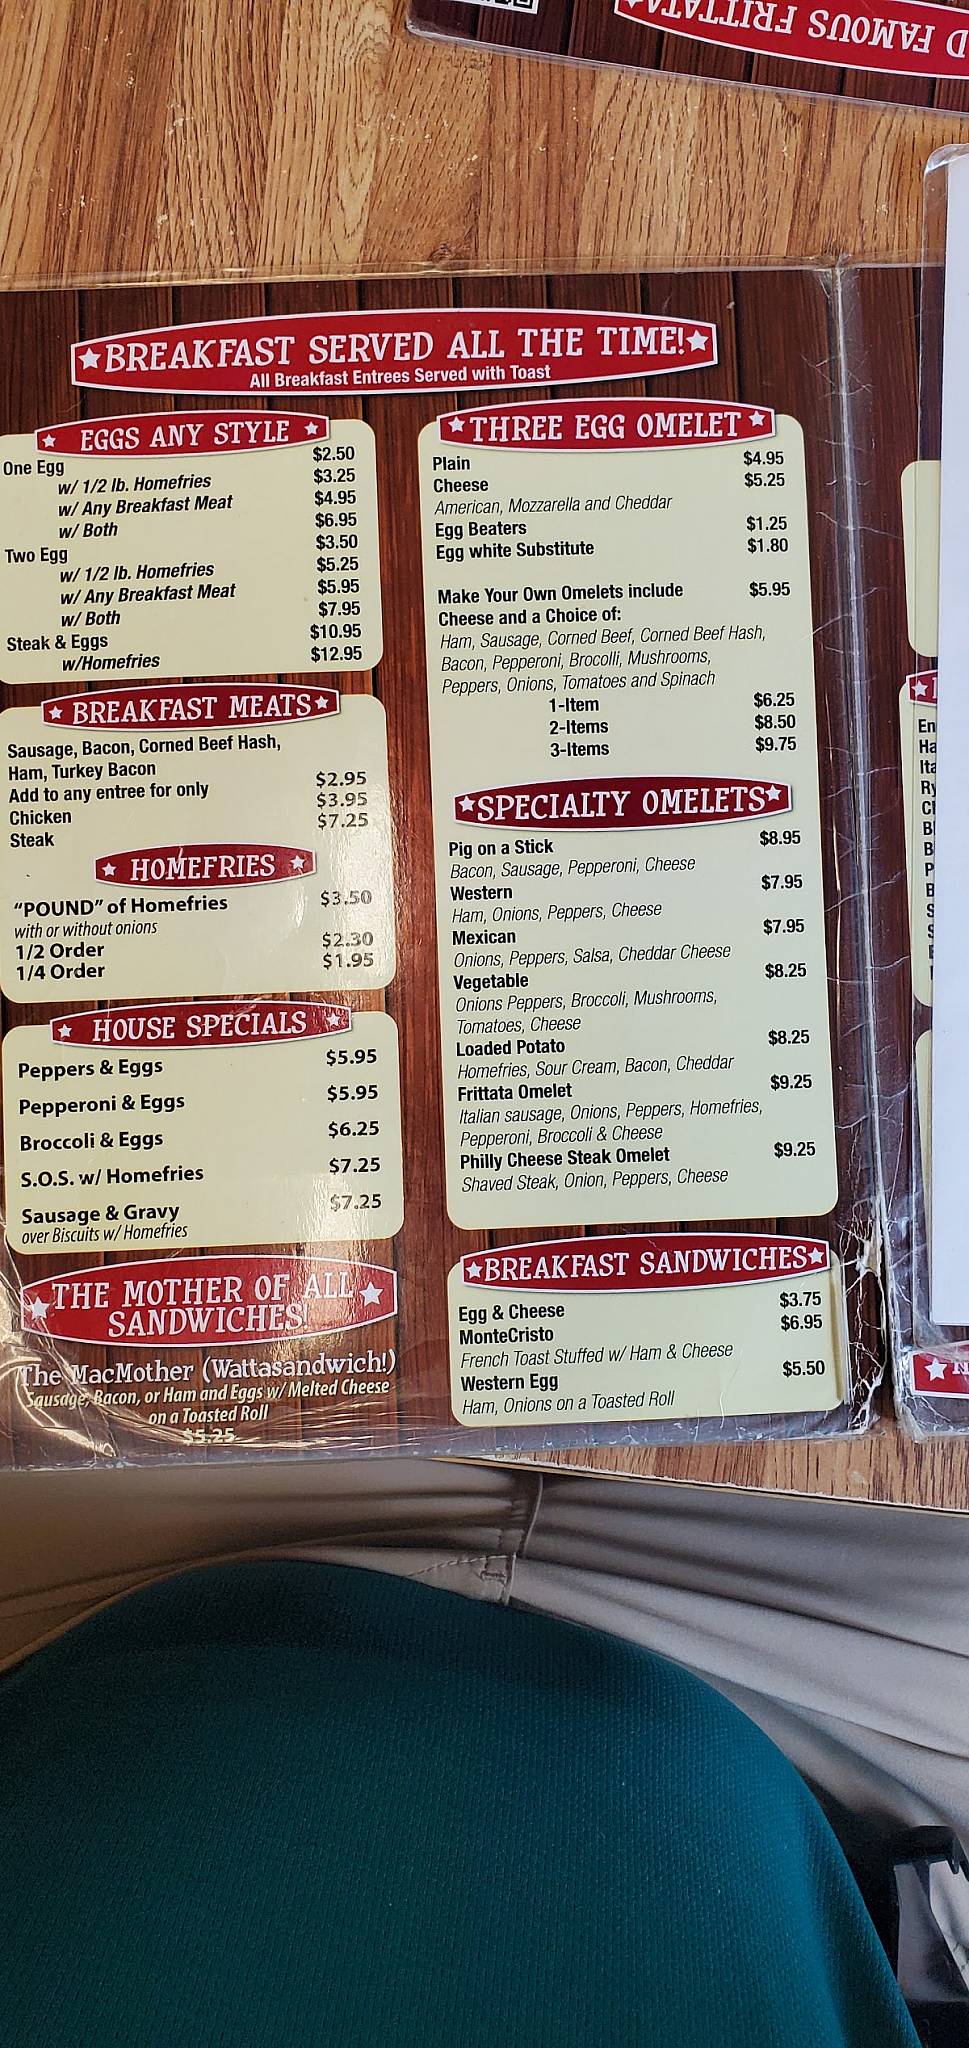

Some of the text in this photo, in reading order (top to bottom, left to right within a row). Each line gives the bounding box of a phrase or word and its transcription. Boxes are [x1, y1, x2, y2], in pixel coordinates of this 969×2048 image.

[808, 9, 936, 55] FAMOUS
[104, 326, 685, 373] BREAKFAST SERVED ALL THE TIME!
[250, 365, 551, 388] All Breakfast Entrees Served with Toast
[81, 420, 289, 451] EGGS ANY STYLE
[470, 412, 741, 442] THREE EGG OMELET
[313, 446, 355, 463] $2.50
[433, 456, 470, 471] Plain
[743, 450, 784, 466] $4.95
[3, 460, 64, 477] One Egg
[314, 468, 355, 485] $3.25
[58, 474, 211, 495] w/ 1/2 lb. Homefries
[434, 478, 488, 493] Cheese
[744, 472, 785, 488] $5.25
[59, 495, 233, 518] w/ Any Breakfast Meat
[314, 490, 356, 507] $4.95
[434, 495, 673, 515] American, Mozzarella and Cheddar
[315, 512, 357, 529] $6.95
[747, 515, 787, 532] $1.25
[59, 522, 118, 538] w/ Both
[435, 521, 527, 540] Egg Beaters
[316, 534, 358, 551] $3.50
[748, 537, 788, 554] $1.80
[4, 547, 67, 565] Two Egg
[317, 556, 359, 573] $5.25
[318, 579, 359, 596] $5.95
[438, 583, 683, 604] Make Your Own Omelets include
[749, 581, 790, 598] $5.95
[319, 601, 360, 618] $7.95
[310, 623, 361, 641] $10.95
[7, 634, 108, 651] Steak & Eggs
[63, 653, 160, 671] w/Homefries
[311, 646, 362, 663] $12.95
[73, 694, 311, 724] BREAKFAST MEATS
[549, 697, 599, 712] 1-Item
[754, 692, 795, 709] $6.25
[8, 734, 280, 760] Sausage, Bacon, Corned Beef Hash,
[550, 742, 609, 757] 3-Items
[755, 736, 796, 753] $9.75
[316, 771, 366, 789] $2.95
[478, 786, 765, 821] SPECIALTY OMELETS
[10, 810, 71, 825] Chicken
[10, 832, 54, 848] Steak
[760, 830, 801, 847] $8.95
[449, 839, 554, 859] Pig on a Stick
[130, 853, 276, 881] HOMEFRIES
[450, 857, 695, 880] Bacon, Sausage, Pepperoni, Cheese
[762, 874, 802, 891] $7.95
[450, 886, 512, 901] Western
[107, 898, 126, 914] of
[131, 895, 228, 913] Homefries
[15, 920, 158, 939] with or without onions
[763, 918, 804, 936] $7.95
[452, 929, 516, 945] Mexican
[16, 941, 104, 960] 1/2 Order
[765, 963, 806, 979] $8.25
[453, 973, 528, 992] Vegetable
[92, 1011, 306, 1042] HOUSE SPECIALS
[768, 1029, 809, 1046] $8.25
[457, 1039, 565, 1056] Loaded Potato
[327, 1049, 377, 1067] $5.95
[458, 1054, 734, 1079] Homefries, Sour Cream, Bacon, Cheddar
[19, 1059, 163, 1081] Peppers & Eggs
[770, 1074, 812, 1091] $9.25
[458, 1083, 572, 1101] Frittata Omelet
[329, 1157, 380, 1175] $7.25
[21, 1165, 203, 1187] S.O.S. w/ Homefries
[22, 1222, 188, 1244] over Biscuits w/ Homefries
[485, 1246, 807, 1281] BREAKFAST SANDWICHES
[52, 1271, 354, 1310] THE MOTHER OF ALL
[780, 1291, 821, 1309] $3.75
[108, 1302, 309, 1338] SANDWICHES!
[459, 1304, 565, 1325] Egg & Cheese
[781, 1314, 822, 1332] $6.95
[460, 1326, 553, 1345] MonteCristo
[20, 1349, 397, 1387] The MacMother (Wattasandwich!)
[783, 1360, 825, 1378] $5.50
[461, 1373, 558, 1392] Western Egg
